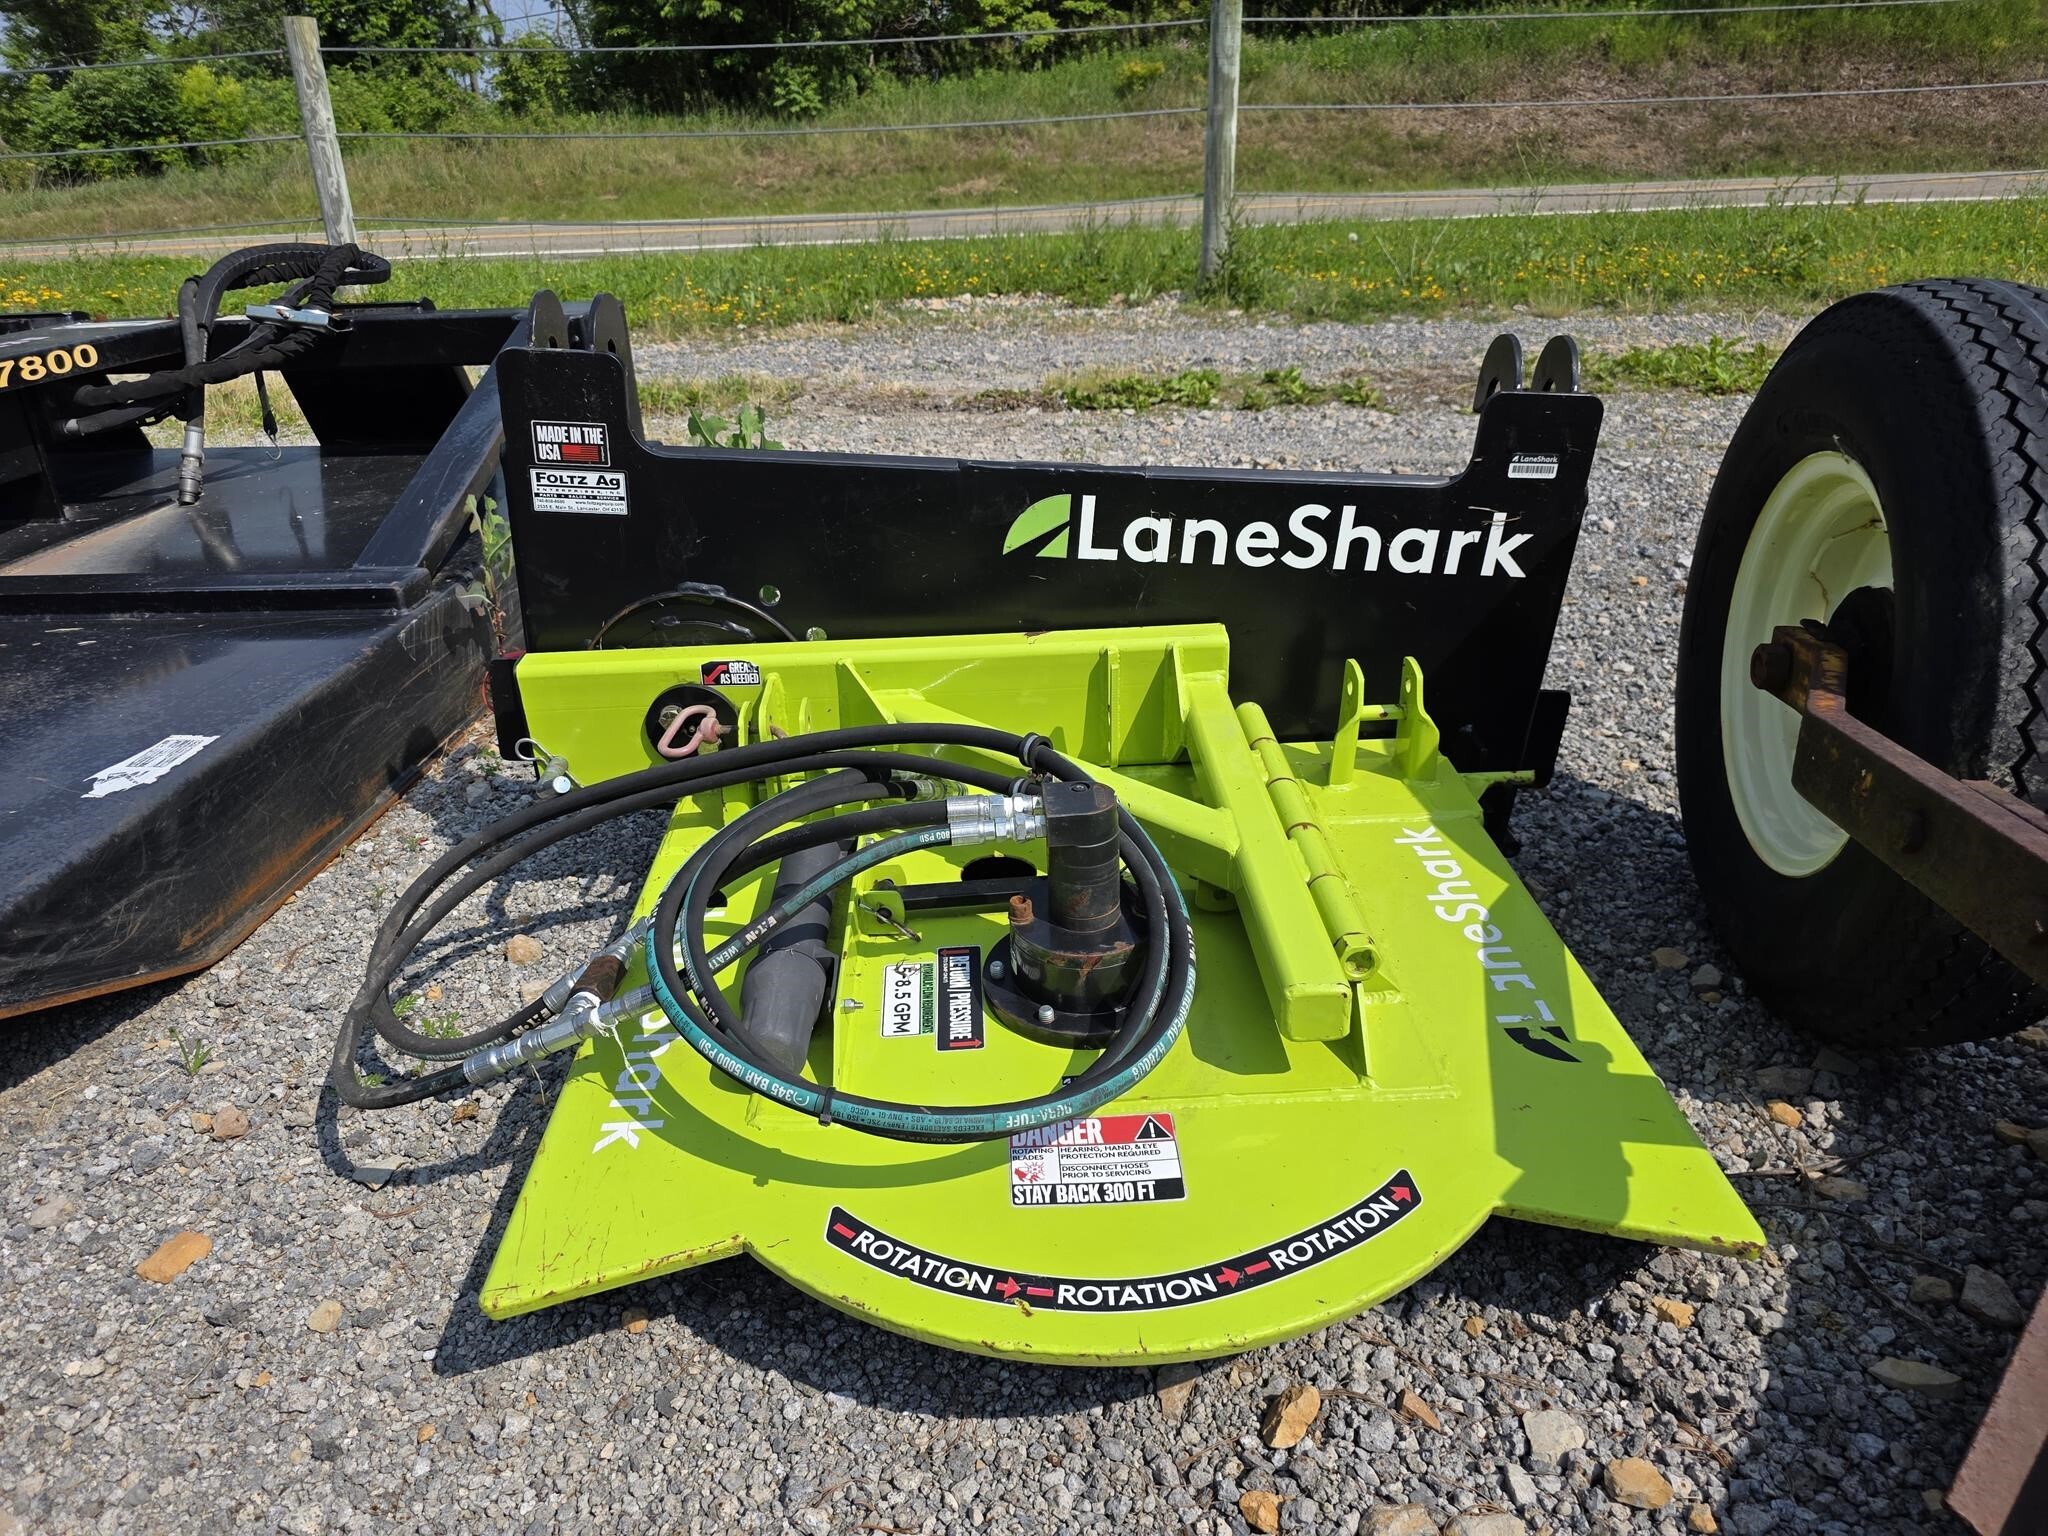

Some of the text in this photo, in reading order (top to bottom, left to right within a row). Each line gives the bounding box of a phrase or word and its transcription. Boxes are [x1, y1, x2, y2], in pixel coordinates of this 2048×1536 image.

[0, 344, 98, 388] 7800
[536, 425, 604, 445] MADE IN THE
[538, 443, 561, 461] USA
[1520, 455, 1558, 463] LaneShark
[595, 474, 621, 489] Ag
[1077, 494, 1534, 578] LaneShark
[720, 674, 759, 684] AS NEEDED
[949, 955, 972, 1040] RETURN PRESSURE
[893, 1002, 912, 1034] GPM
[745, 1069, 770, 1091] BAR
[771, 1083, 794, 1102] 345
[1012, 1118, 1104, 1147] DANGER
[1012, 1147, 1055, 1155] ROTATING
[1060, 1146, 1103, 1154] HEARING,
[1104, 1144, 1134, 1152] HAND,
[1061, 1149, 1161, 1160] PROTECTION REQUIRED
[1062, 1164, 1119, 1172] DISCONNECT
[1105, 1169, 1152, 1177] SERVICING
[1013, 1180, 1156, 1204] STAY BACK 300 FT
[851, 1195, 1397, 1306] ROTATION ROTATION ROTATION
